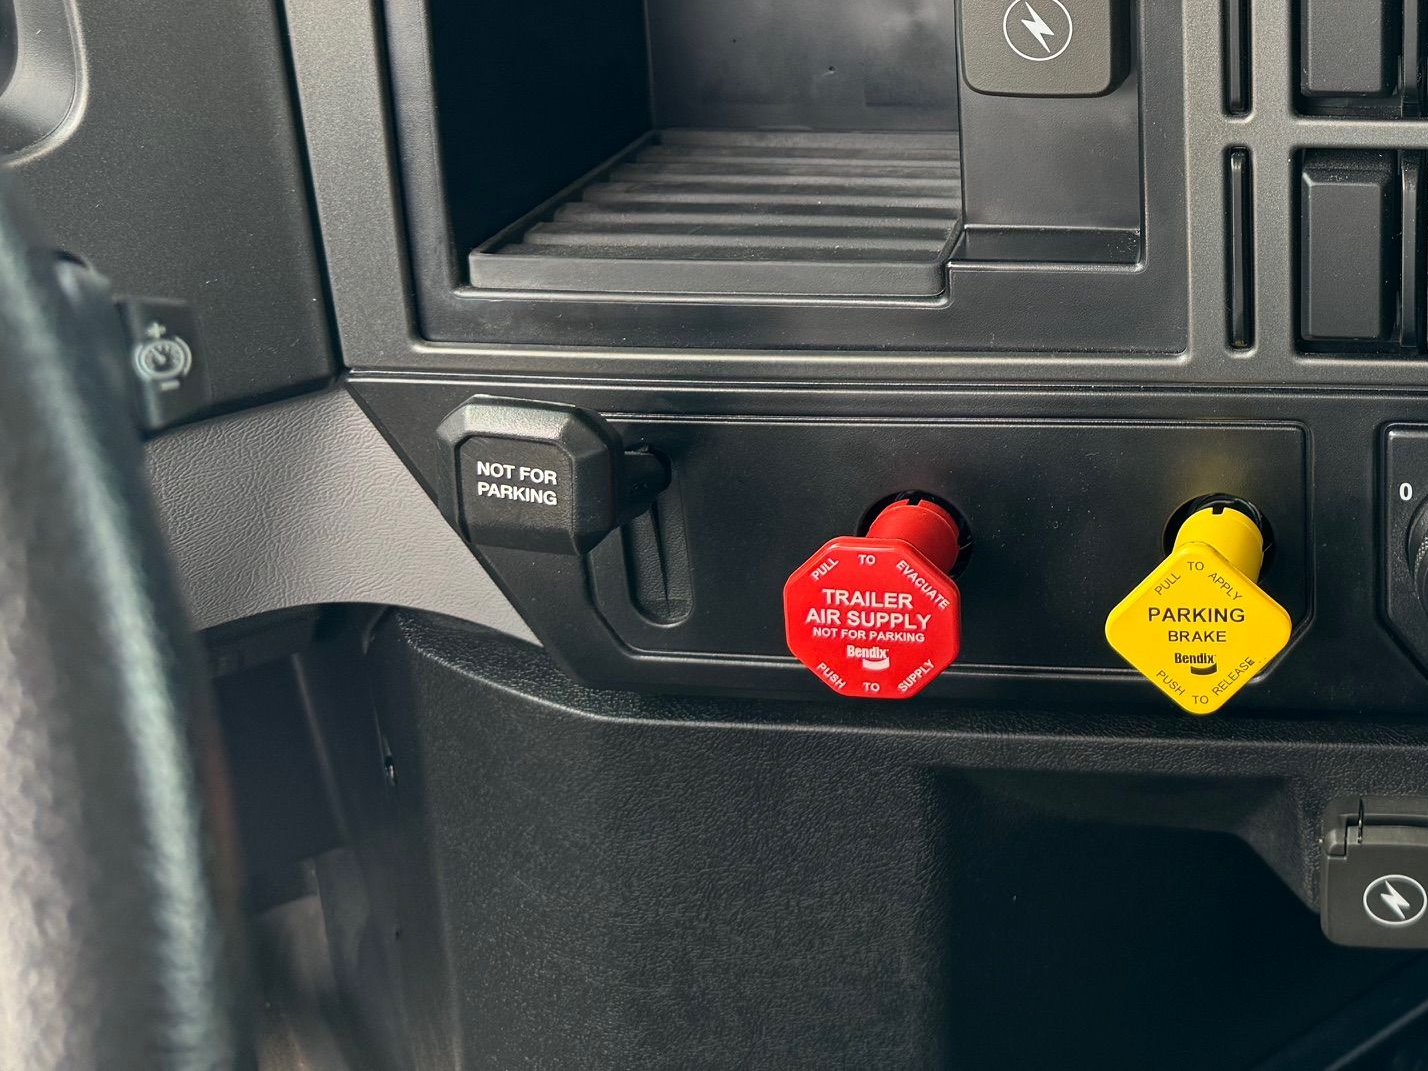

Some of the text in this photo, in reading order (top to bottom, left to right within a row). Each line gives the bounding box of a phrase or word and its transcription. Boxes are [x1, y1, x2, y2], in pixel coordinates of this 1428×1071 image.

[477, 461, 557, 485] NOT FOR
[478, 481, 558, 506] PARKING
[811, 554, 951, 610] PULL TO EVACUATE
[1154, 561, 1243, 601] PULL TO APPLY
[822, 589, 913, 609] TRAILER
[805, 608, 931, 630] AIR SUPPLY
[1149, 607, 1245, 623] PARKING
[813, 627, 925, 642] NOT FOR PARKING
[1168, 631, 1227, 642] BRAKE
[847, 645, 888, 658] Bendix
[1174, 653, 1215, 664] Bendix
[817, 659, 935, 693] PUSH TO SUPPLY
[1156, 656, 1255, 704] PUSH TO RELEASE
